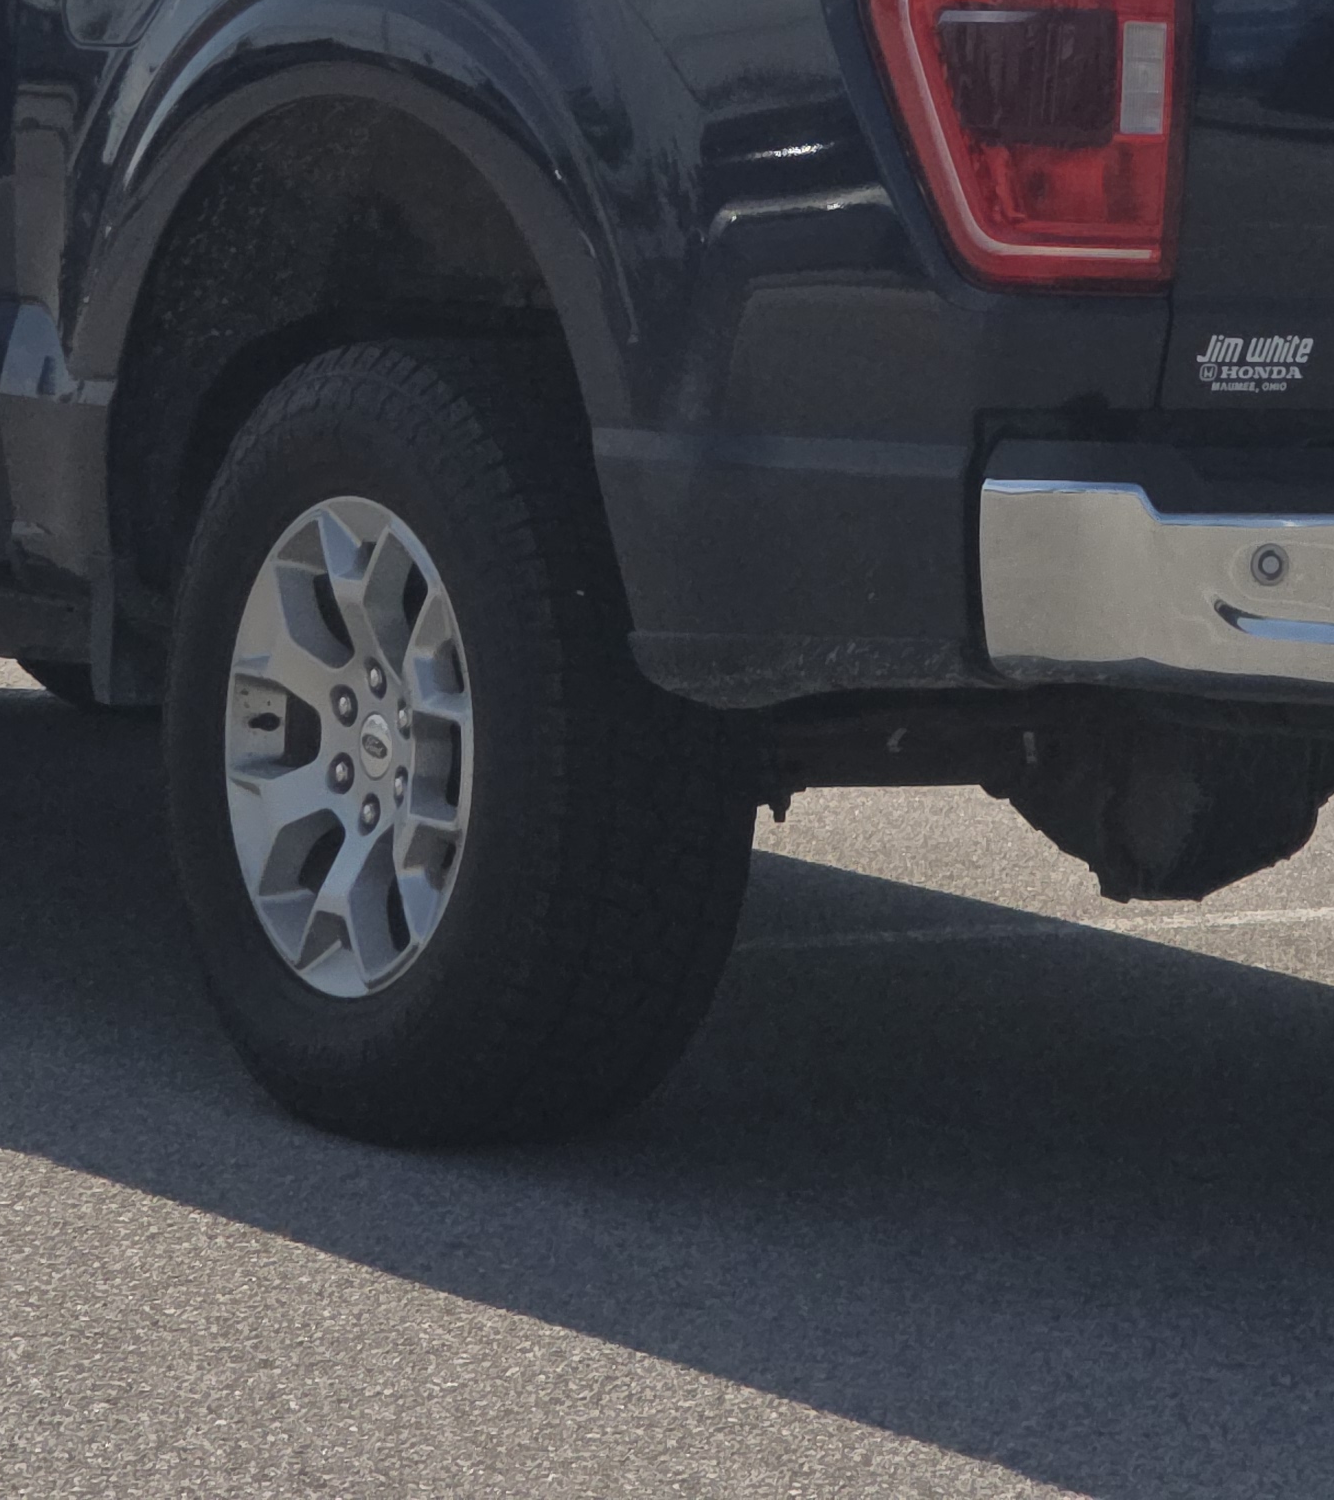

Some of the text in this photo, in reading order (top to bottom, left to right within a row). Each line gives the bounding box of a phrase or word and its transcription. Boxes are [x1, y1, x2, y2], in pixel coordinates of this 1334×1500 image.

[1196, 334, 1244, 363] Jim
[1220, 366, 1303, 379] HONDA
[1261, 382, 1288, 392] OHIO
